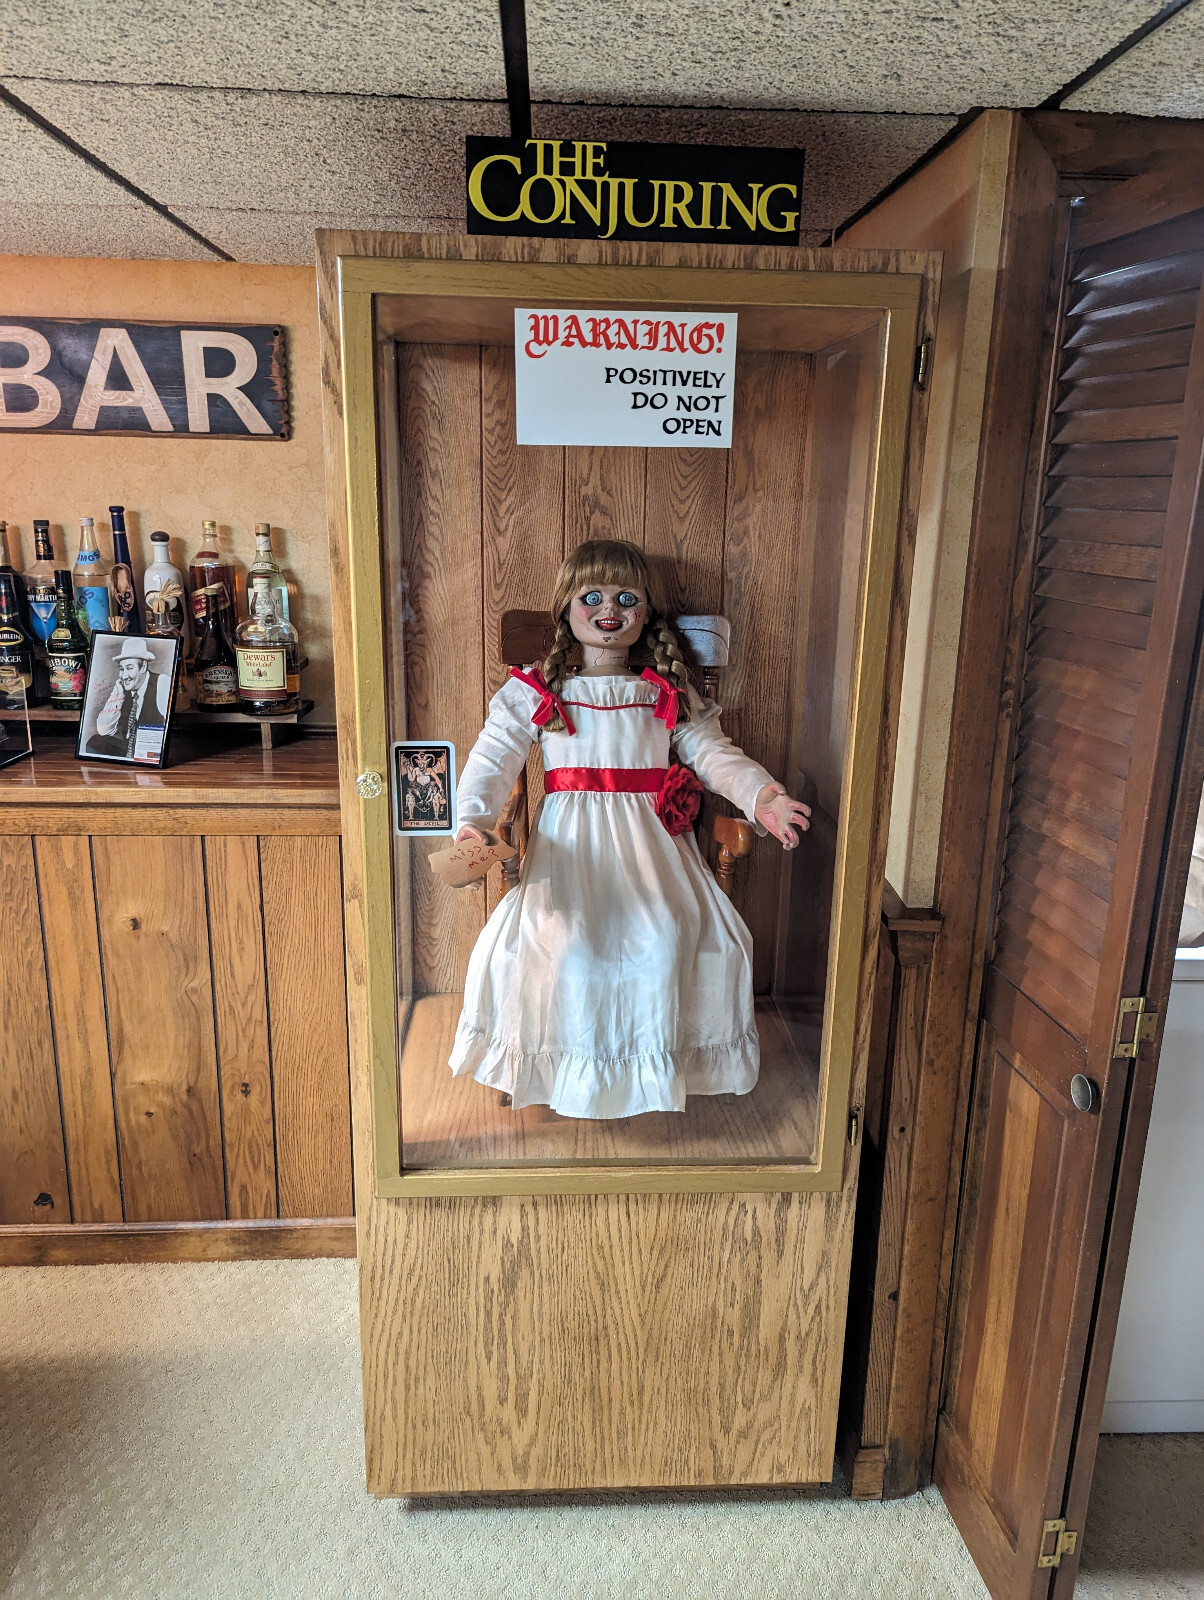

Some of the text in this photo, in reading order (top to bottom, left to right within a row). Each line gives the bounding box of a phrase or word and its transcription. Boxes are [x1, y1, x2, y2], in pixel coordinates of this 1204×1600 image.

[525, 138, 610, 179] THE
[468, 154, 800, 239] CONJURING
[524, 313, 726, 359] WARNING!
[0, 325, 274, 435] BAR
[604, 366, 727, 389] POSITIVELY
[631, 392, 727, 413] DO NOT
[661, 417, 723, 437] OPEN
[242, 652, 276, 662] Dewar's
